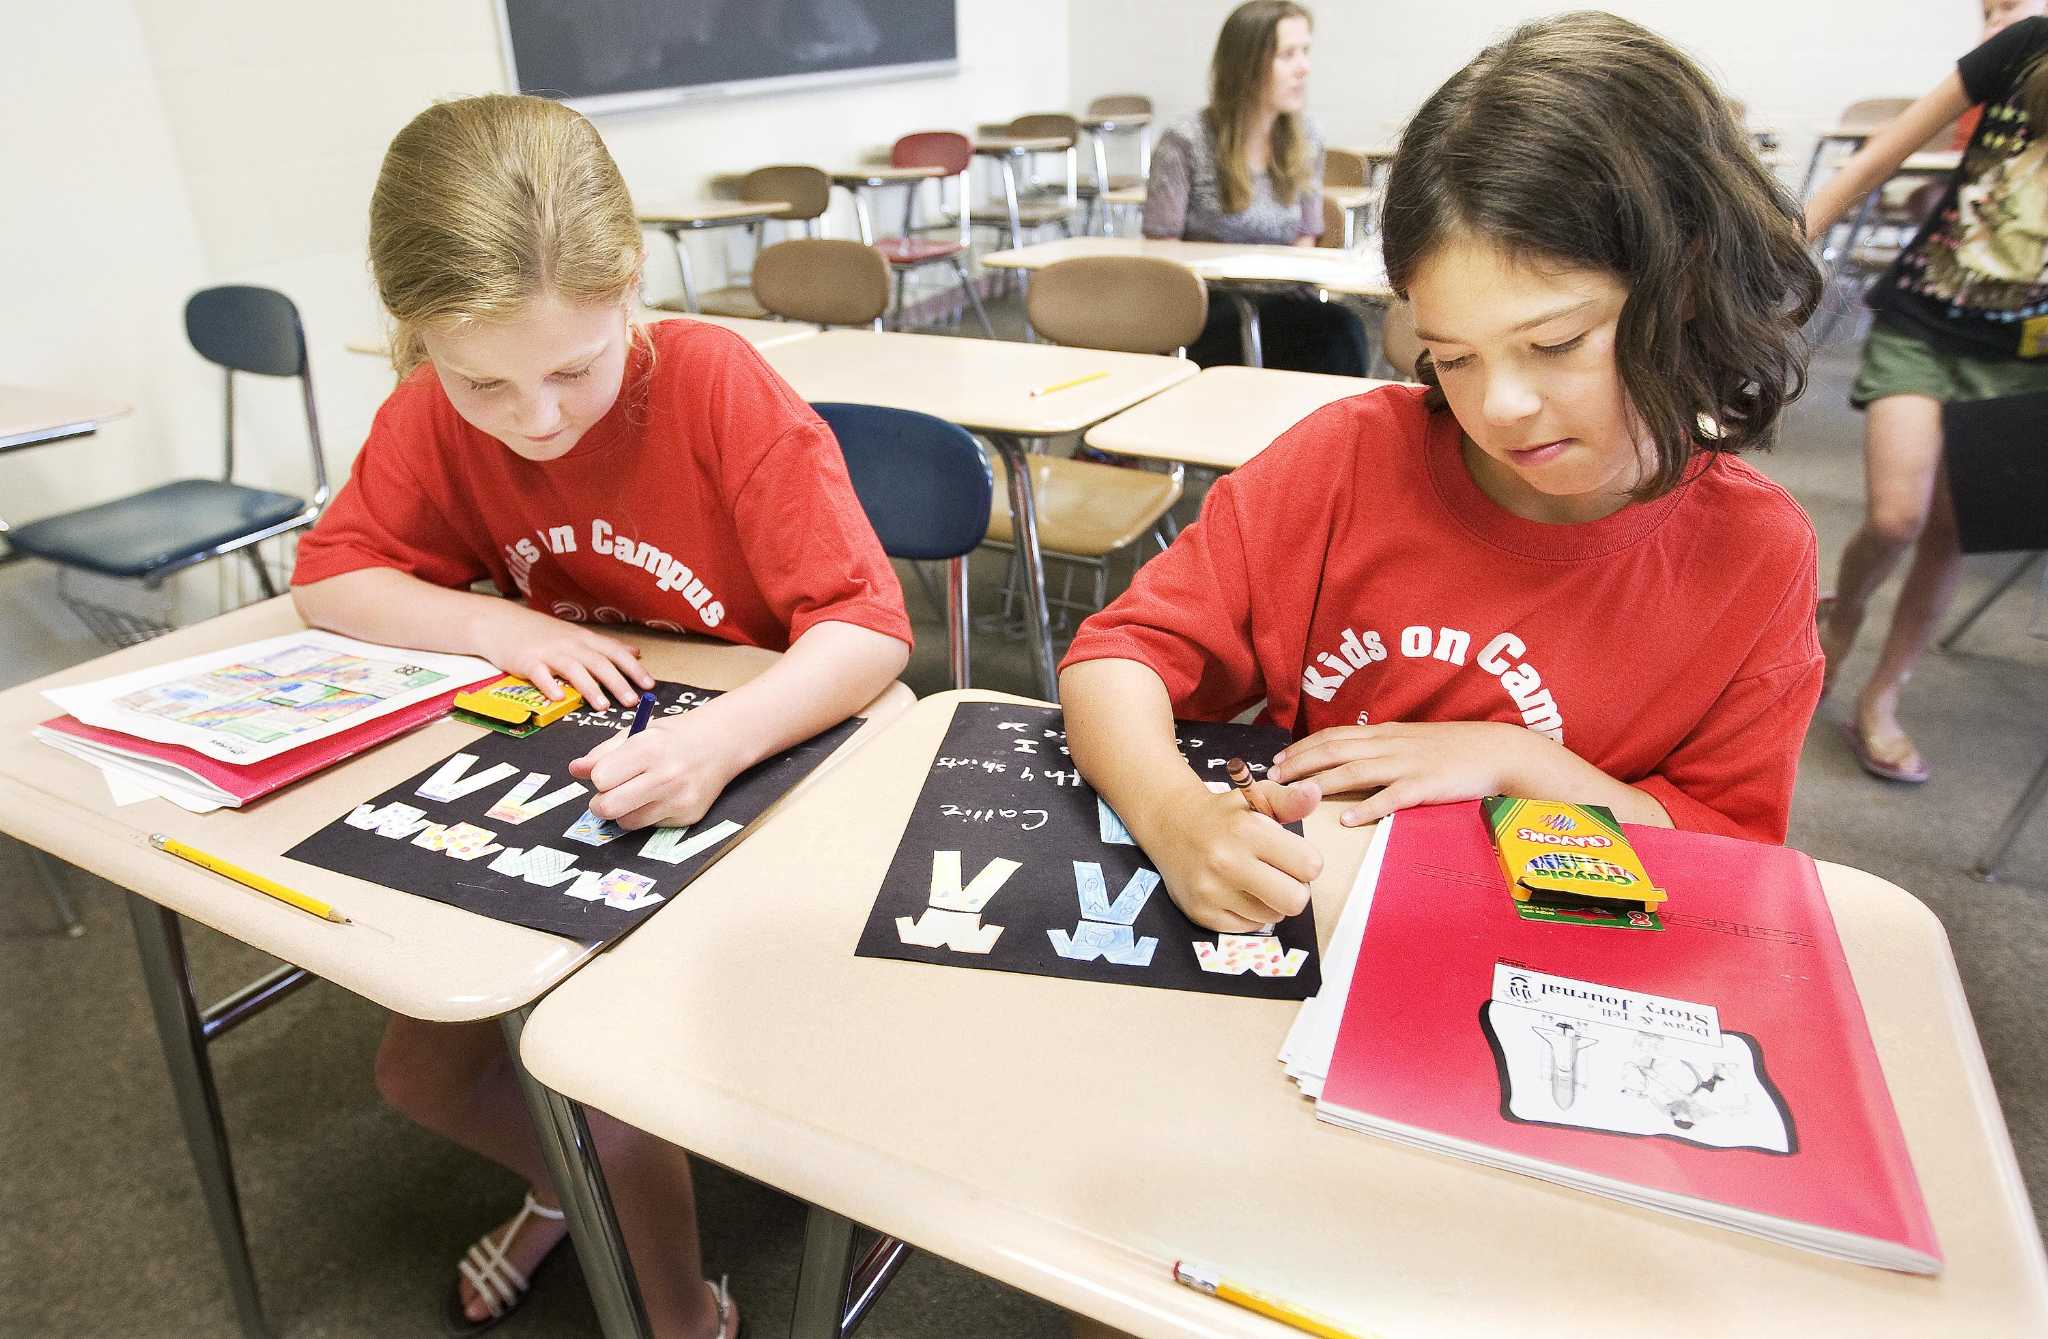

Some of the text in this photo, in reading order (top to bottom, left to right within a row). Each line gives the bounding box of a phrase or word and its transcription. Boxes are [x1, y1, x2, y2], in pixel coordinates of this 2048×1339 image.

[537, 524, 577, 554] n
[591, 518, 725, 628] Campus
[1302, 625, 1564, 745] Kids on Cam
[1517, 828, 1613, 848] CRAYONS
[1534, 868, 1632, 885] Crayola
[1541, 983, 1633, 1010] Journal
[1602, 1008, 1628, 1021] Tell
[1645, 1002, 1709, 1025] Story
[1662, 1021, 1709, 1037] Draw
